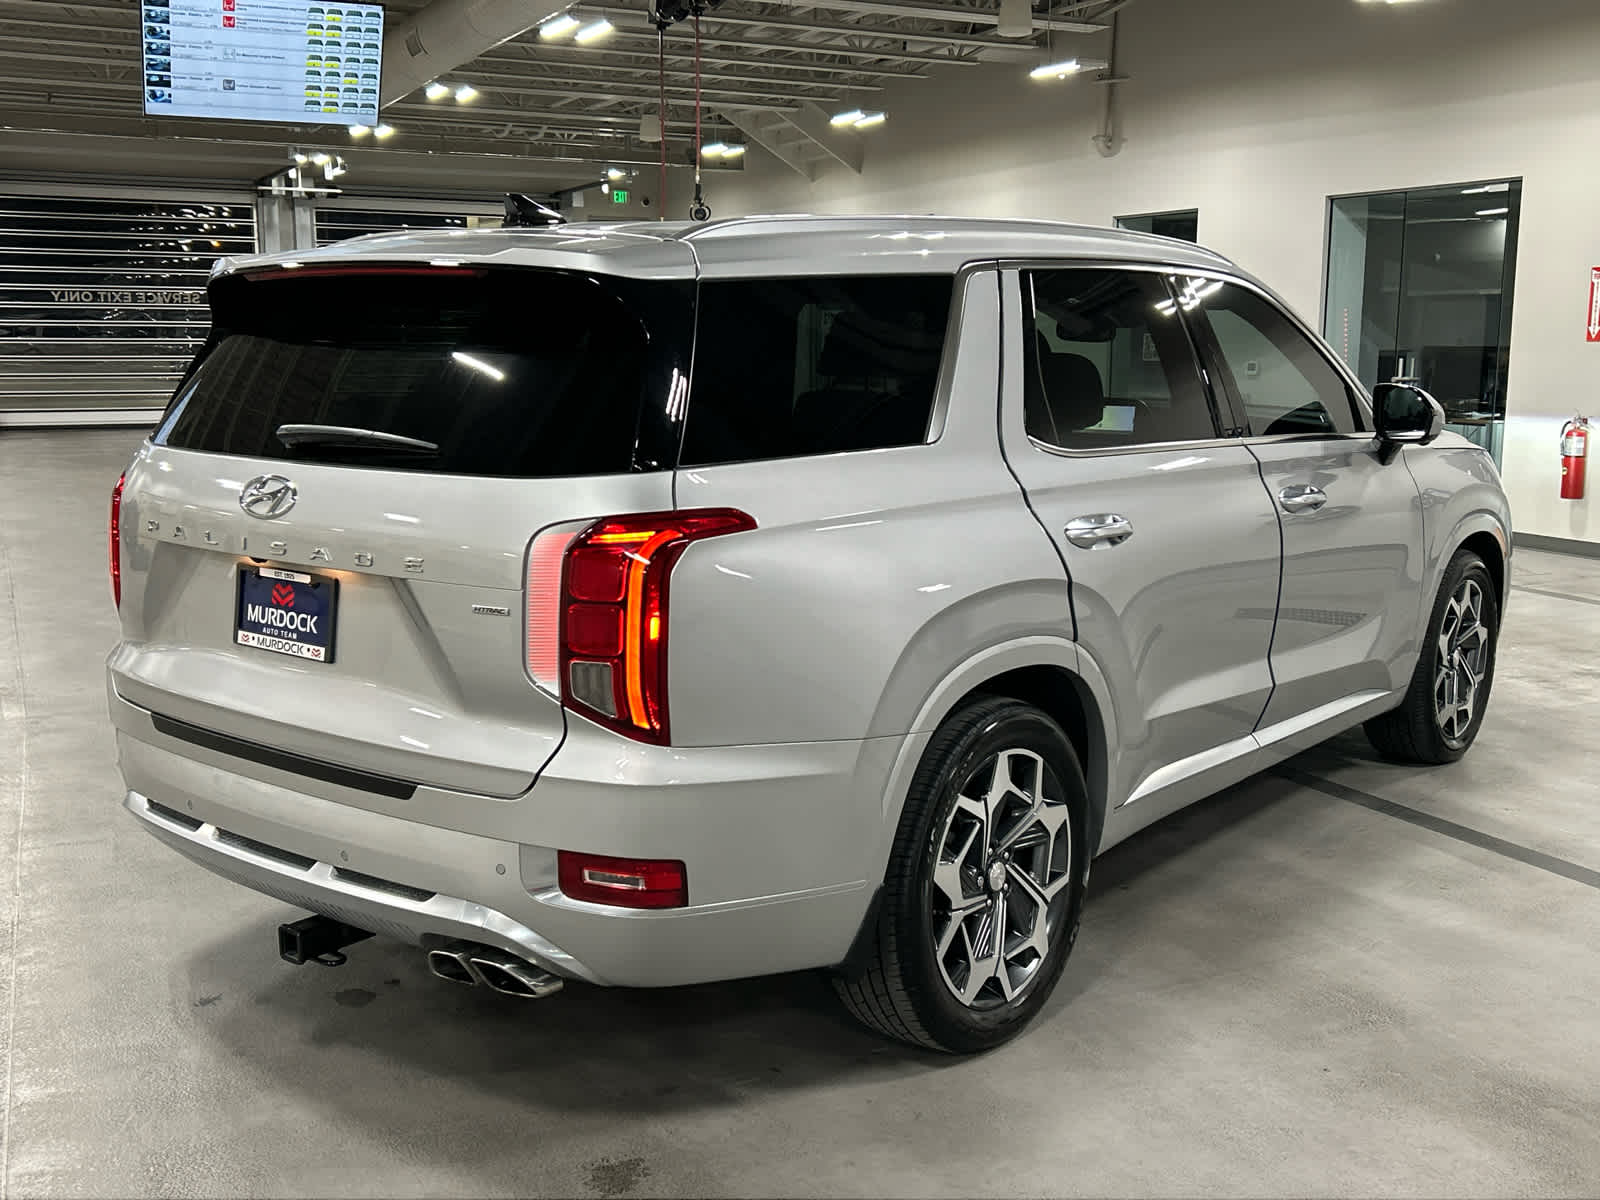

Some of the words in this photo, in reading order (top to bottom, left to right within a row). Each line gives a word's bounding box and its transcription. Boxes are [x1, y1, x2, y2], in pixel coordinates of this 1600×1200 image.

[613, 190, 628, 204] EXIT
[147, 520, 425, 574] PALISADE
[247, 603, 318, 634] MURDOCK
[262, 627, 279, 636] AUTO
[280, 630, 298, 640] TEAM
[257, 636, 304, 655] MURDOCK
